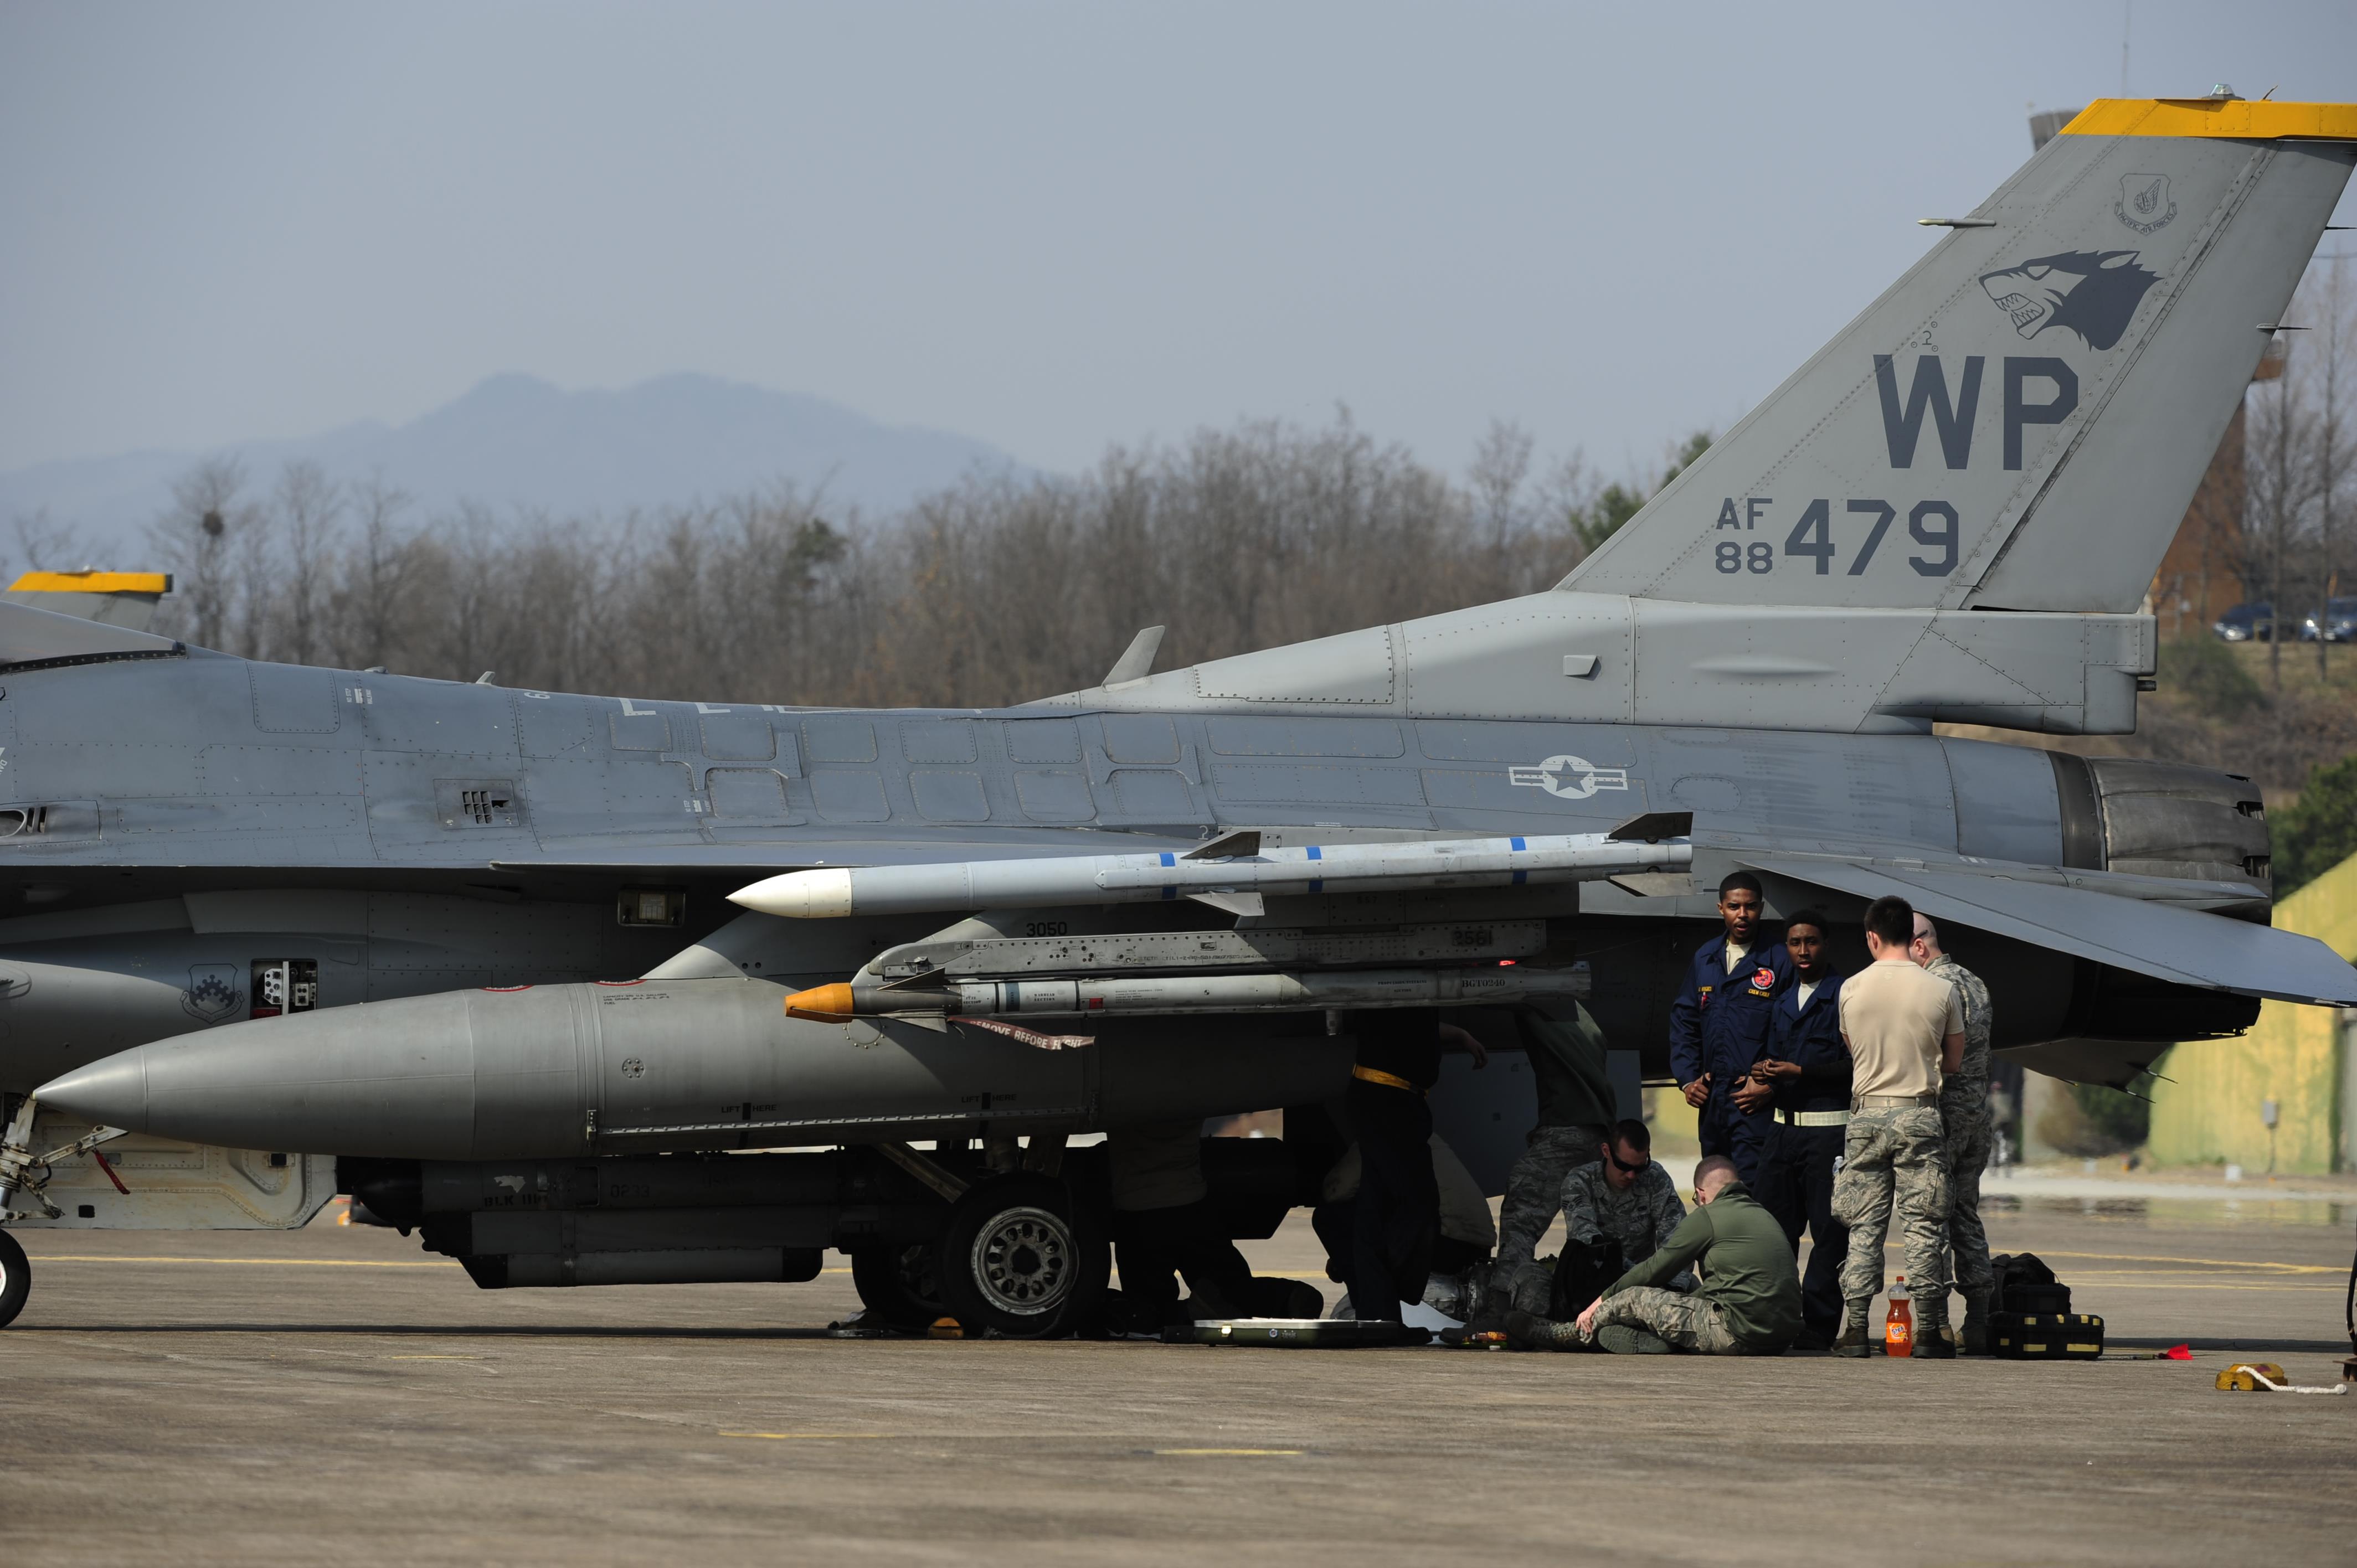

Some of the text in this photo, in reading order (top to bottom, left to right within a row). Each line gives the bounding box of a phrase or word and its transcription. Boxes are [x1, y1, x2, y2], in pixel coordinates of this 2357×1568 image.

[2118, 212, 2140, 229] PACIFIC
[2153, 212, 2174, 230] FORCES
[1873, 354, 2078, 471] WP
[1716, 498, 1772, 530] AF
[1784, 499, 1959, 577] 479
[1716, 541, 1772, 574] 88
[1026, 921, 1067, 937] 3050
[1461, 978, 1505, 987] BGT0240
[1014, 1030, 1048, 1049] BEFORE
[992, 1094, 1017, 1102] HERE
[485, 1195, 514, 1206] BLK
